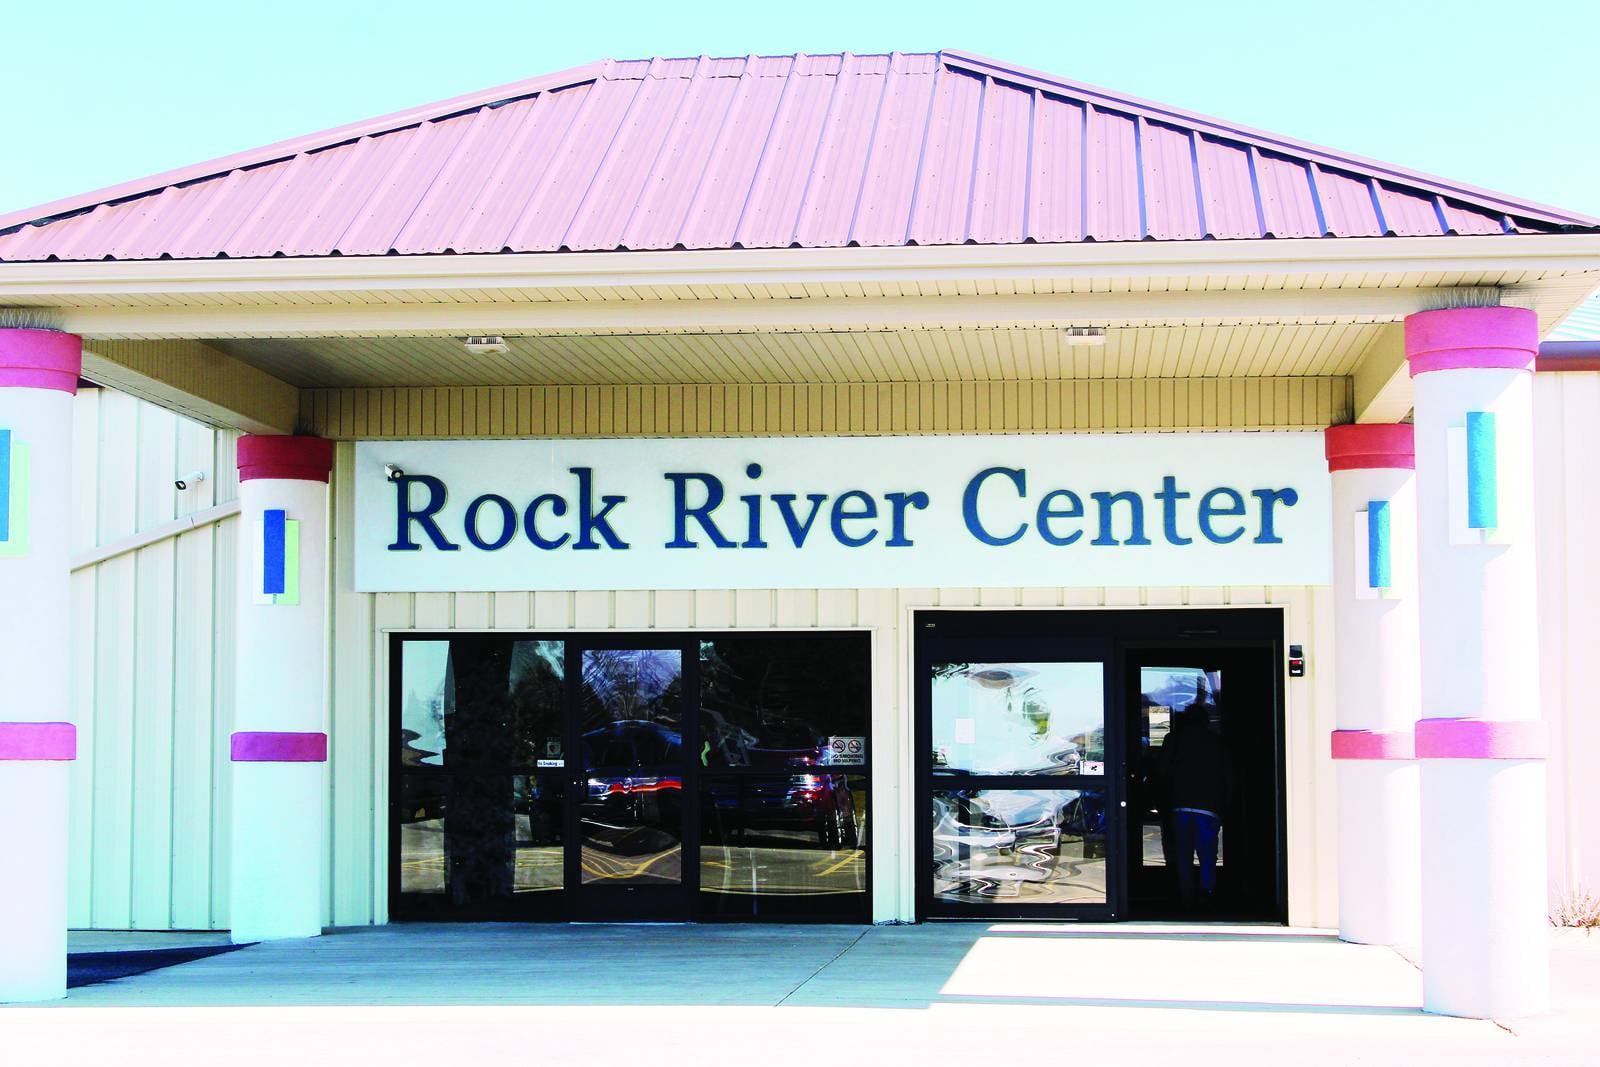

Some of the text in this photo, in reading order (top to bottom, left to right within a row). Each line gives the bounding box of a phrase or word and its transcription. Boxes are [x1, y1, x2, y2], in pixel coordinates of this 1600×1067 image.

[387, 463, 1299, 552] Rock River Center
